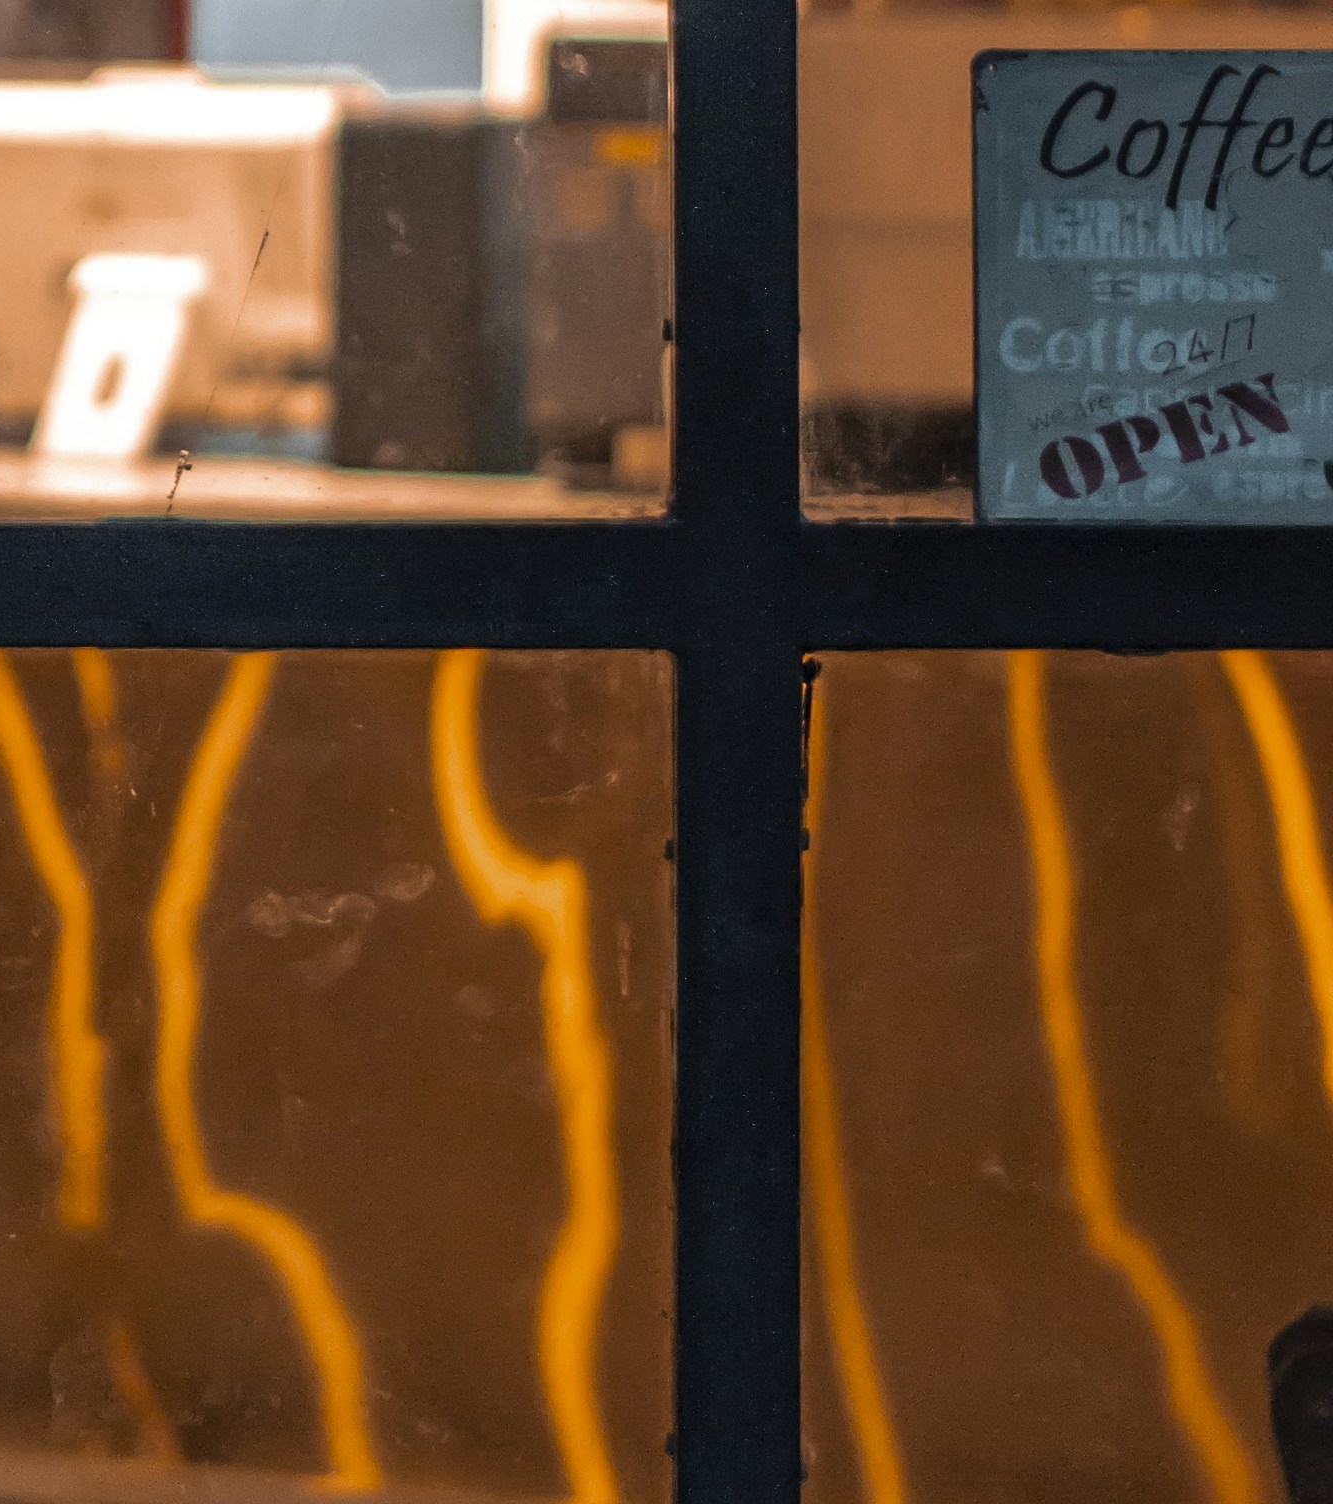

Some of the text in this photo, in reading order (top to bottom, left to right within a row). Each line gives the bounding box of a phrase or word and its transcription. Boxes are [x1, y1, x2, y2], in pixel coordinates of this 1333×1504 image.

[1039, 62, 1333, 212] Coffee
[1158, 312, 1256, 376] 24/7
[1039, 372, 1290, 499] OPEN
